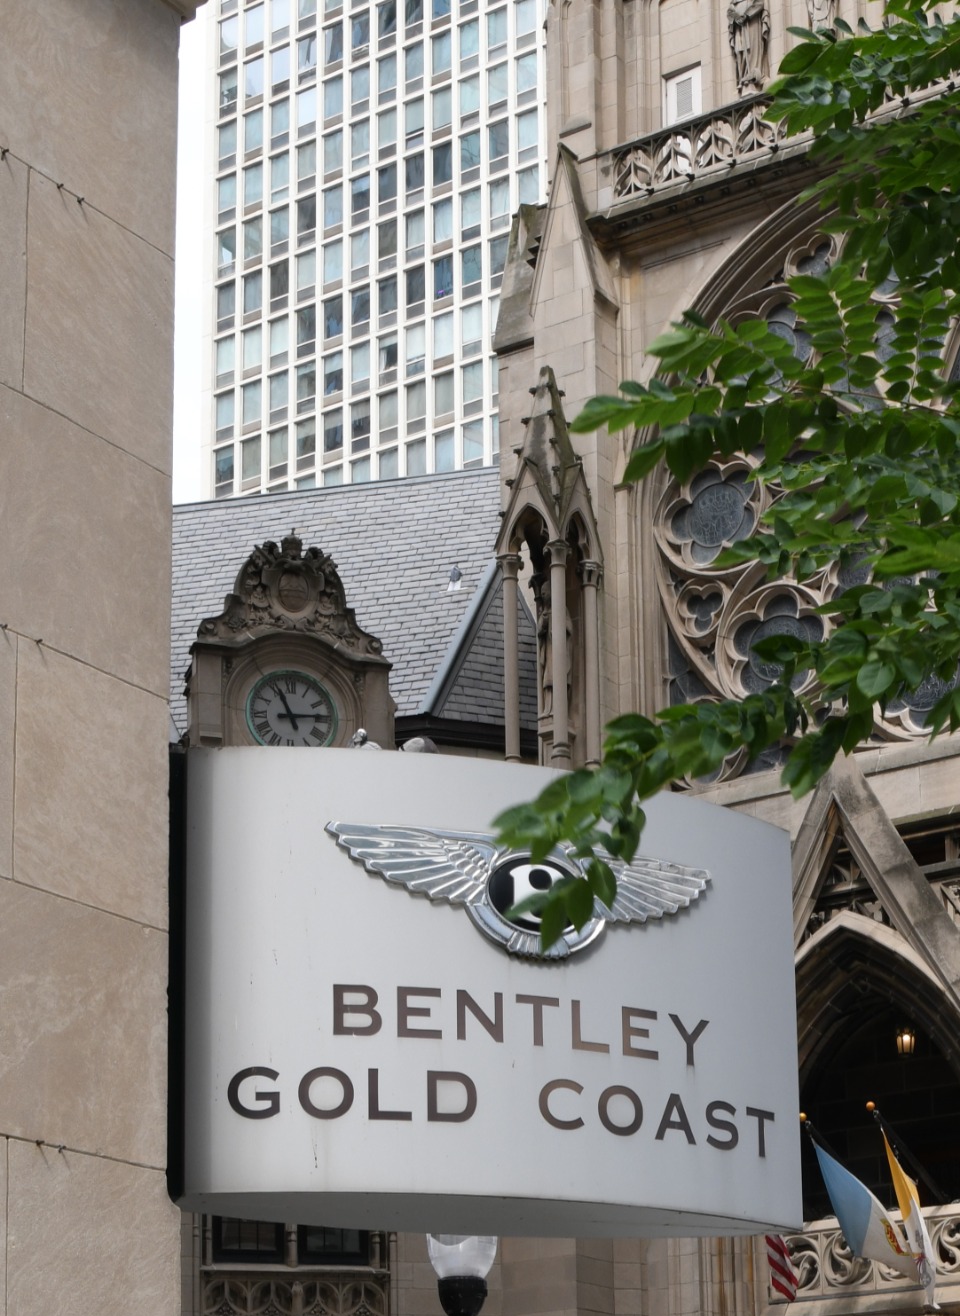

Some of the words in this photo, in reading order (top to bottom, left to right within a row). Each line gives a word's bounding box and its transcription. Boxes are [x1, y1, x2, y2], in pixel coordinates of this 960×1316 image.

[332, 983, 710, 1067] BENTLEY
[227, 1065, 478, 1123] GOLD
[538, 1078, 775, 1158] COAST
